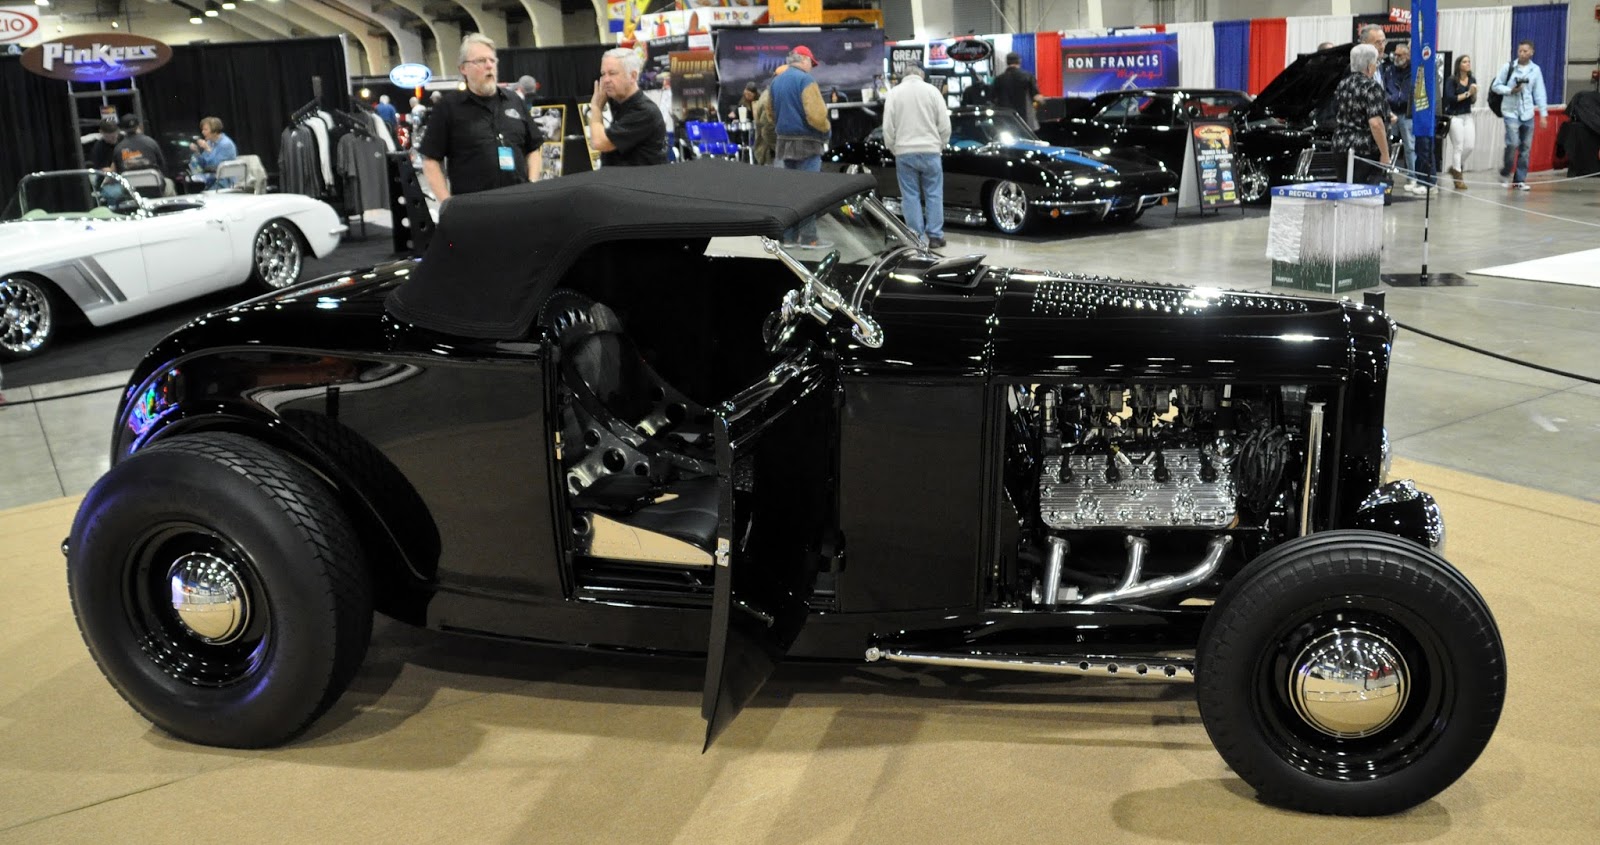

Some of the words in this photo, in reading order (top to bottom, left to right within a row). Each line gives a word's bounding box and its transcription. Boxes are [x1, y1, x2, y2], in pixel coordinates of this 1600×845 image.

[713, 11, 730, 20] HOT
[732, 10, 749, 20] DOG
[0, 18, 25, 31] IO
[893, 49, 922, 61] GREAT
[1067, 57, 1094, 69] RON
[1100, 54, 1159, 68] FRANCIS
[1288, 190, 1317, 198] RECYCLE
[1351, 189, 1373, 197] RECYCLE
